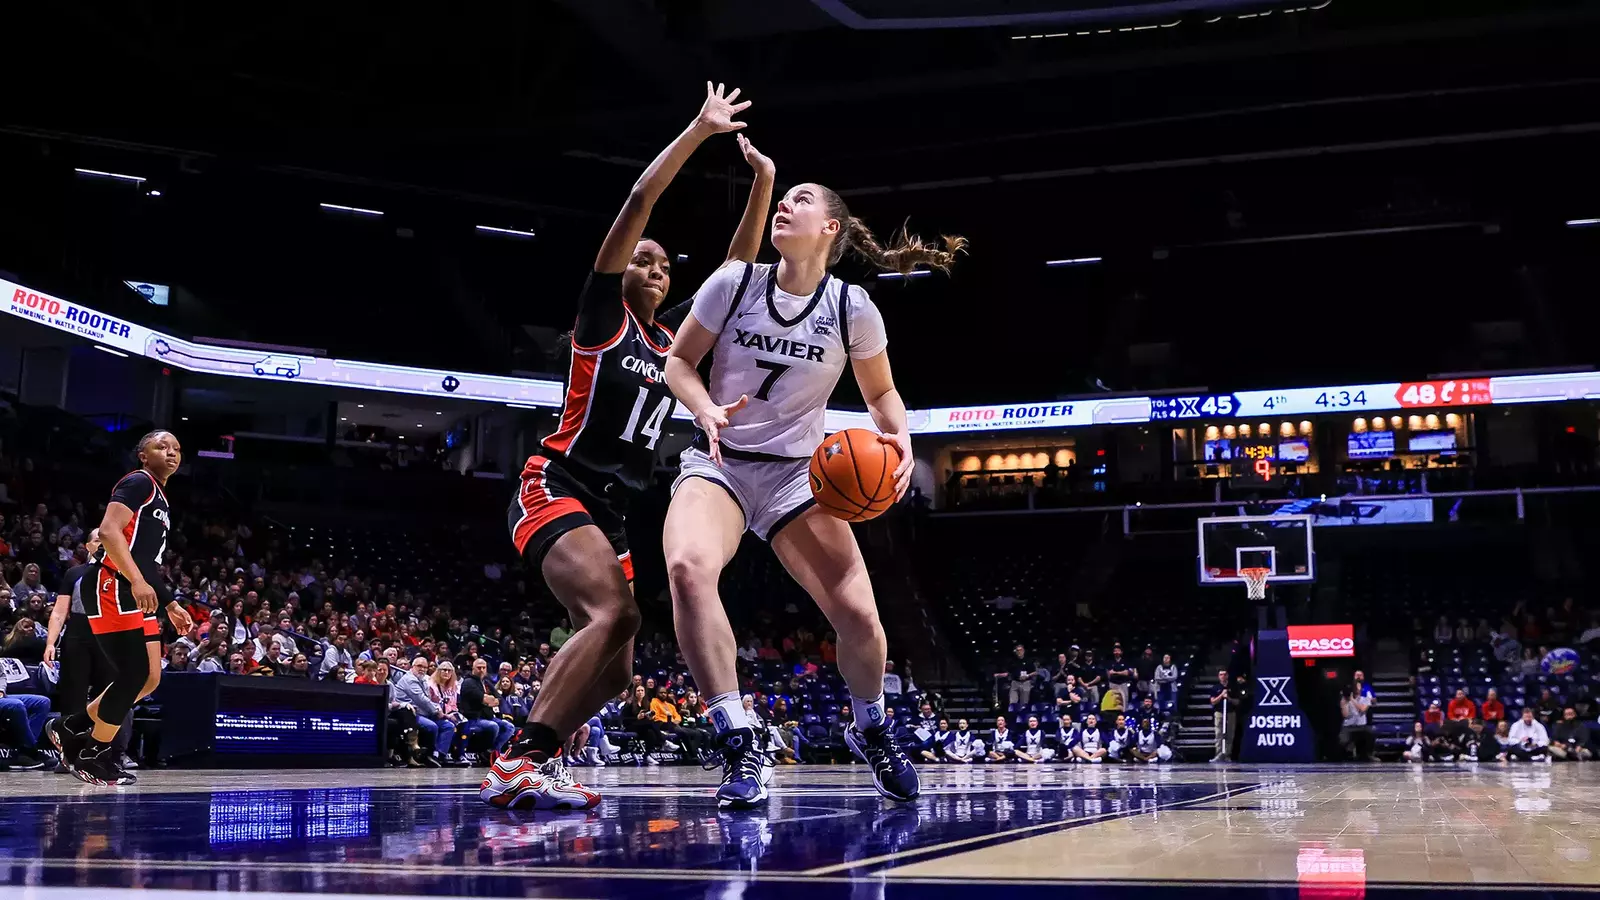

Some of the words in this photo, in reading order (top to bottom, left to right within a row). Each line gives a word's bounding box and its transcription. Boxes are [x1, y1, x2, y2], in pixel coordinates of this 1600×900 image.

[10, 304, 46, 321] PLUMBING
[55, 318, 75, 330] WATER
[77, 326, 105, 339] CLEANUP
[12, 288, 131, 339] ROTO-ROOTER
[732, 328, 825, 363] XAVIER
[753, 358, 793, 401] 7
[1152, 400, 1167, 408] TOL
[1169, 399, 1177, 408] 4
[1200, 396, 1233, 415] 45
[1263, 395, 1287, 410] 4th
[1315, 390, 1367, 408] 4:34
[1402, 384, 1436, 404] 48
[618, 385, 672, 450] 14
[948, 405, 1074, 421] ROTO-ROOTER
[1152, 411, 1168, 419] FLS
[1169, 410, 1177, 418] 4
[1245, 445, 1273, 459] 4:34
[1255, 460, 1269, 481] 9
[1288, 638, 1354, 651] PRASCO
[1249, 715, 1301, 728] JOSEPH
[1257, 733, 1295, 746] AUTO
